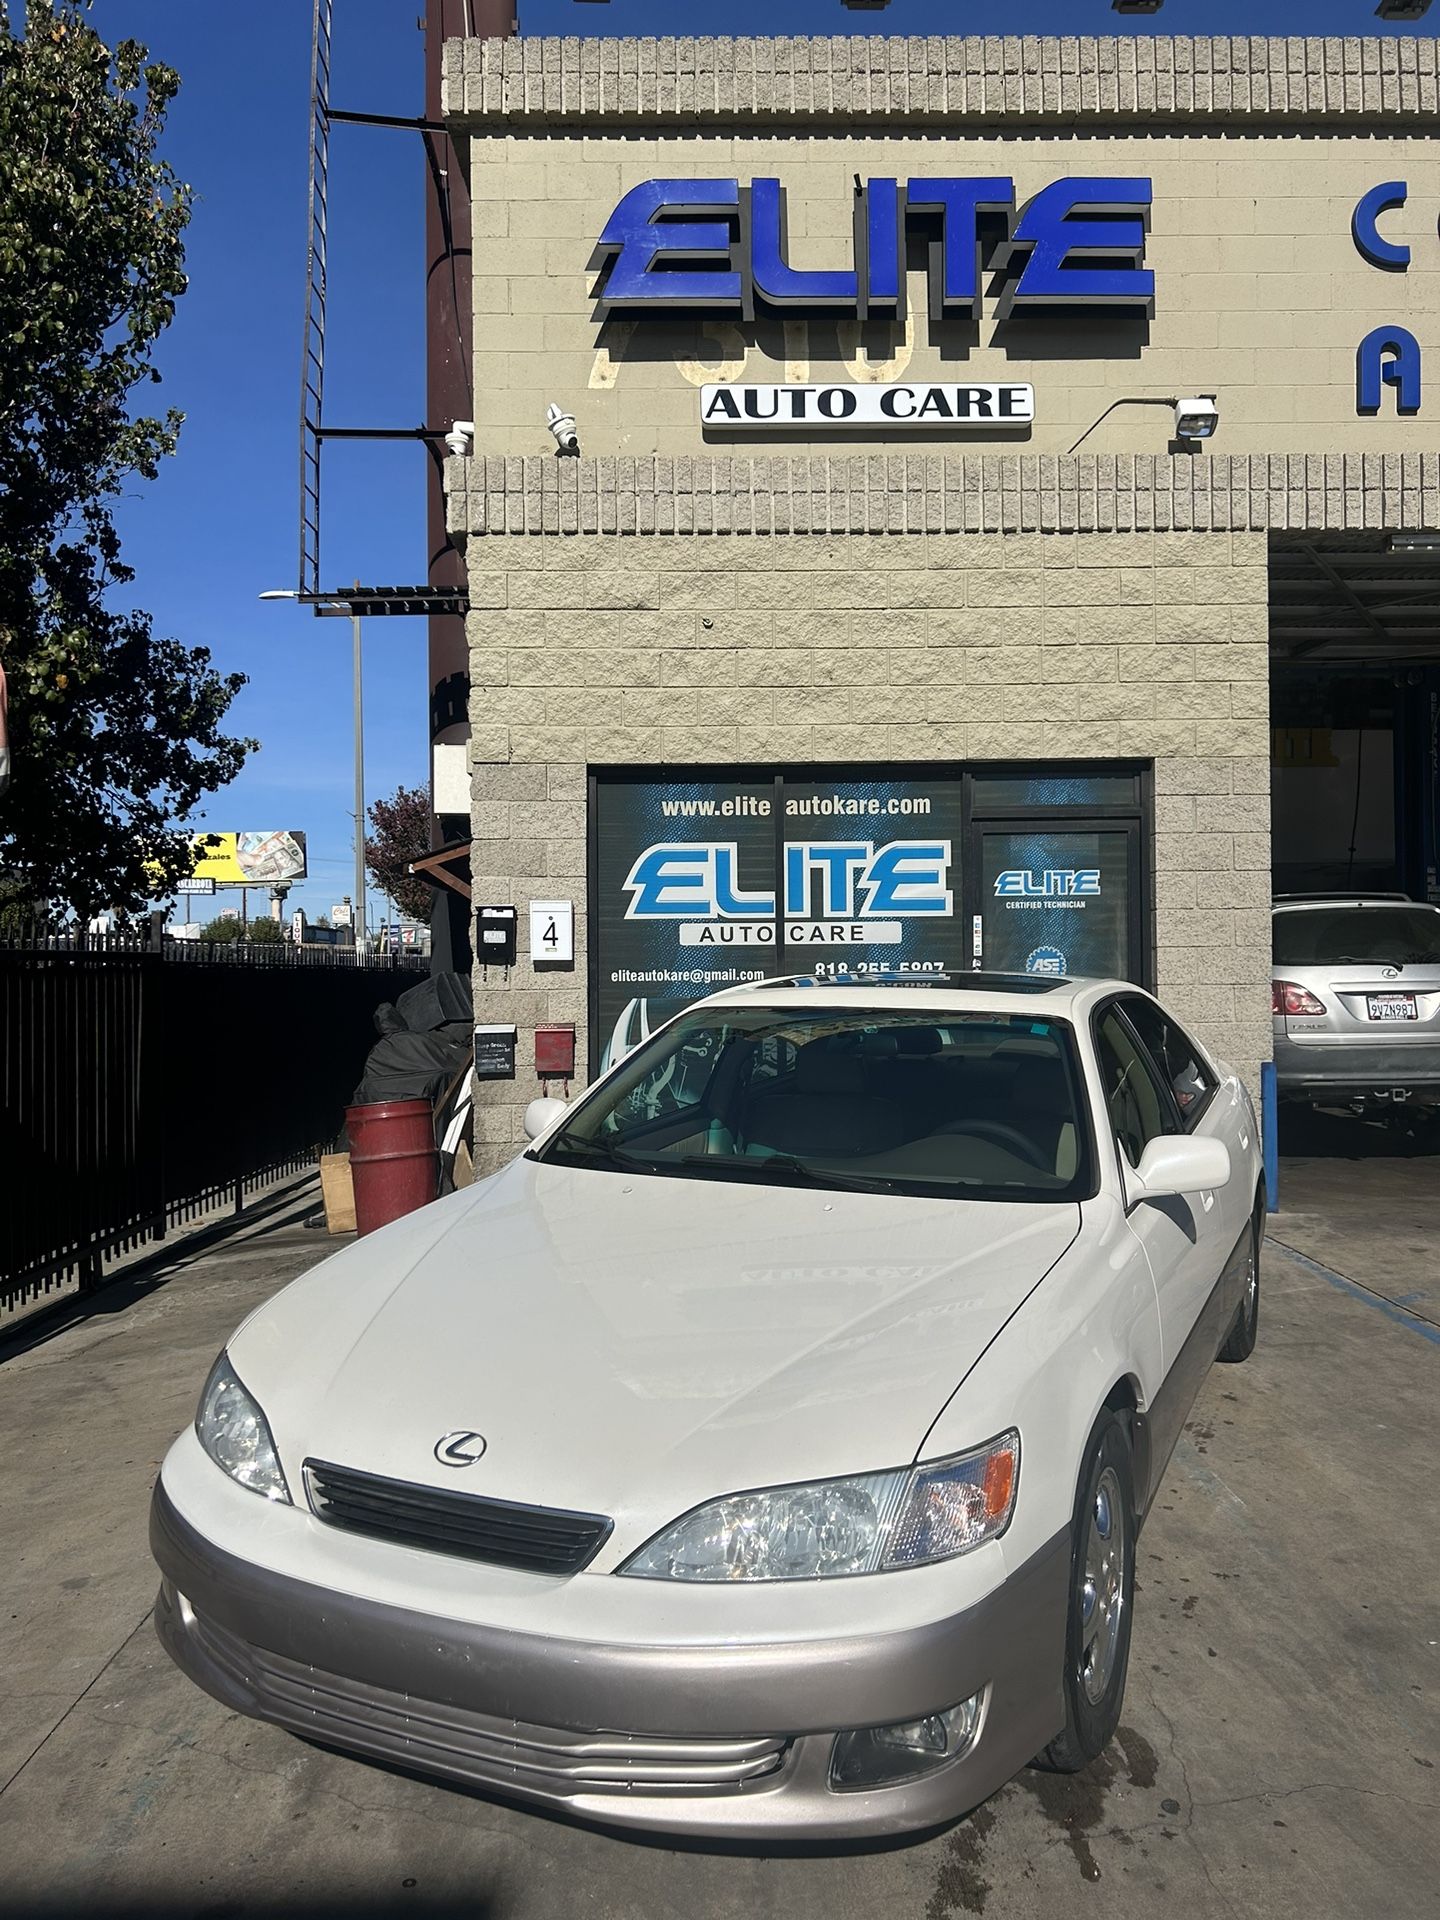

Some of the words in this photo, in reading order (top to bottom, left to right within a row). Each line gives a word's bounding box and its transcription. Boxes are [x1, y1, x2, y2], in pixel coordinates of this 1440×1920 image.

[1351, 181, 1440, 272] C
[598, 176, 1155, 307] ELITE
[1356, 325, 1421, 416] A
[705, 387, 858, 419] AUTO
[879, 387, 1032, 418] CARE
[661, 796, 772, 816] www.elite
[785, 795, 931, 816] autokare.com
[622, 840, 954, 920] ELITE
[993, 869, 1101, 897] ELITE
[1005, 901, 1042, 909] CERTIFIED
[1043, 900, 1086, 909] TECHNICIAN
[542, 921, 559, 947] 4
[699, 926, 774, 943] AUTO
[789, 925, 864, 942] CARE
[611, 968, 765, 984] eliteautokare@gmail.com
[1031, 958, 1060, 972] ASE
